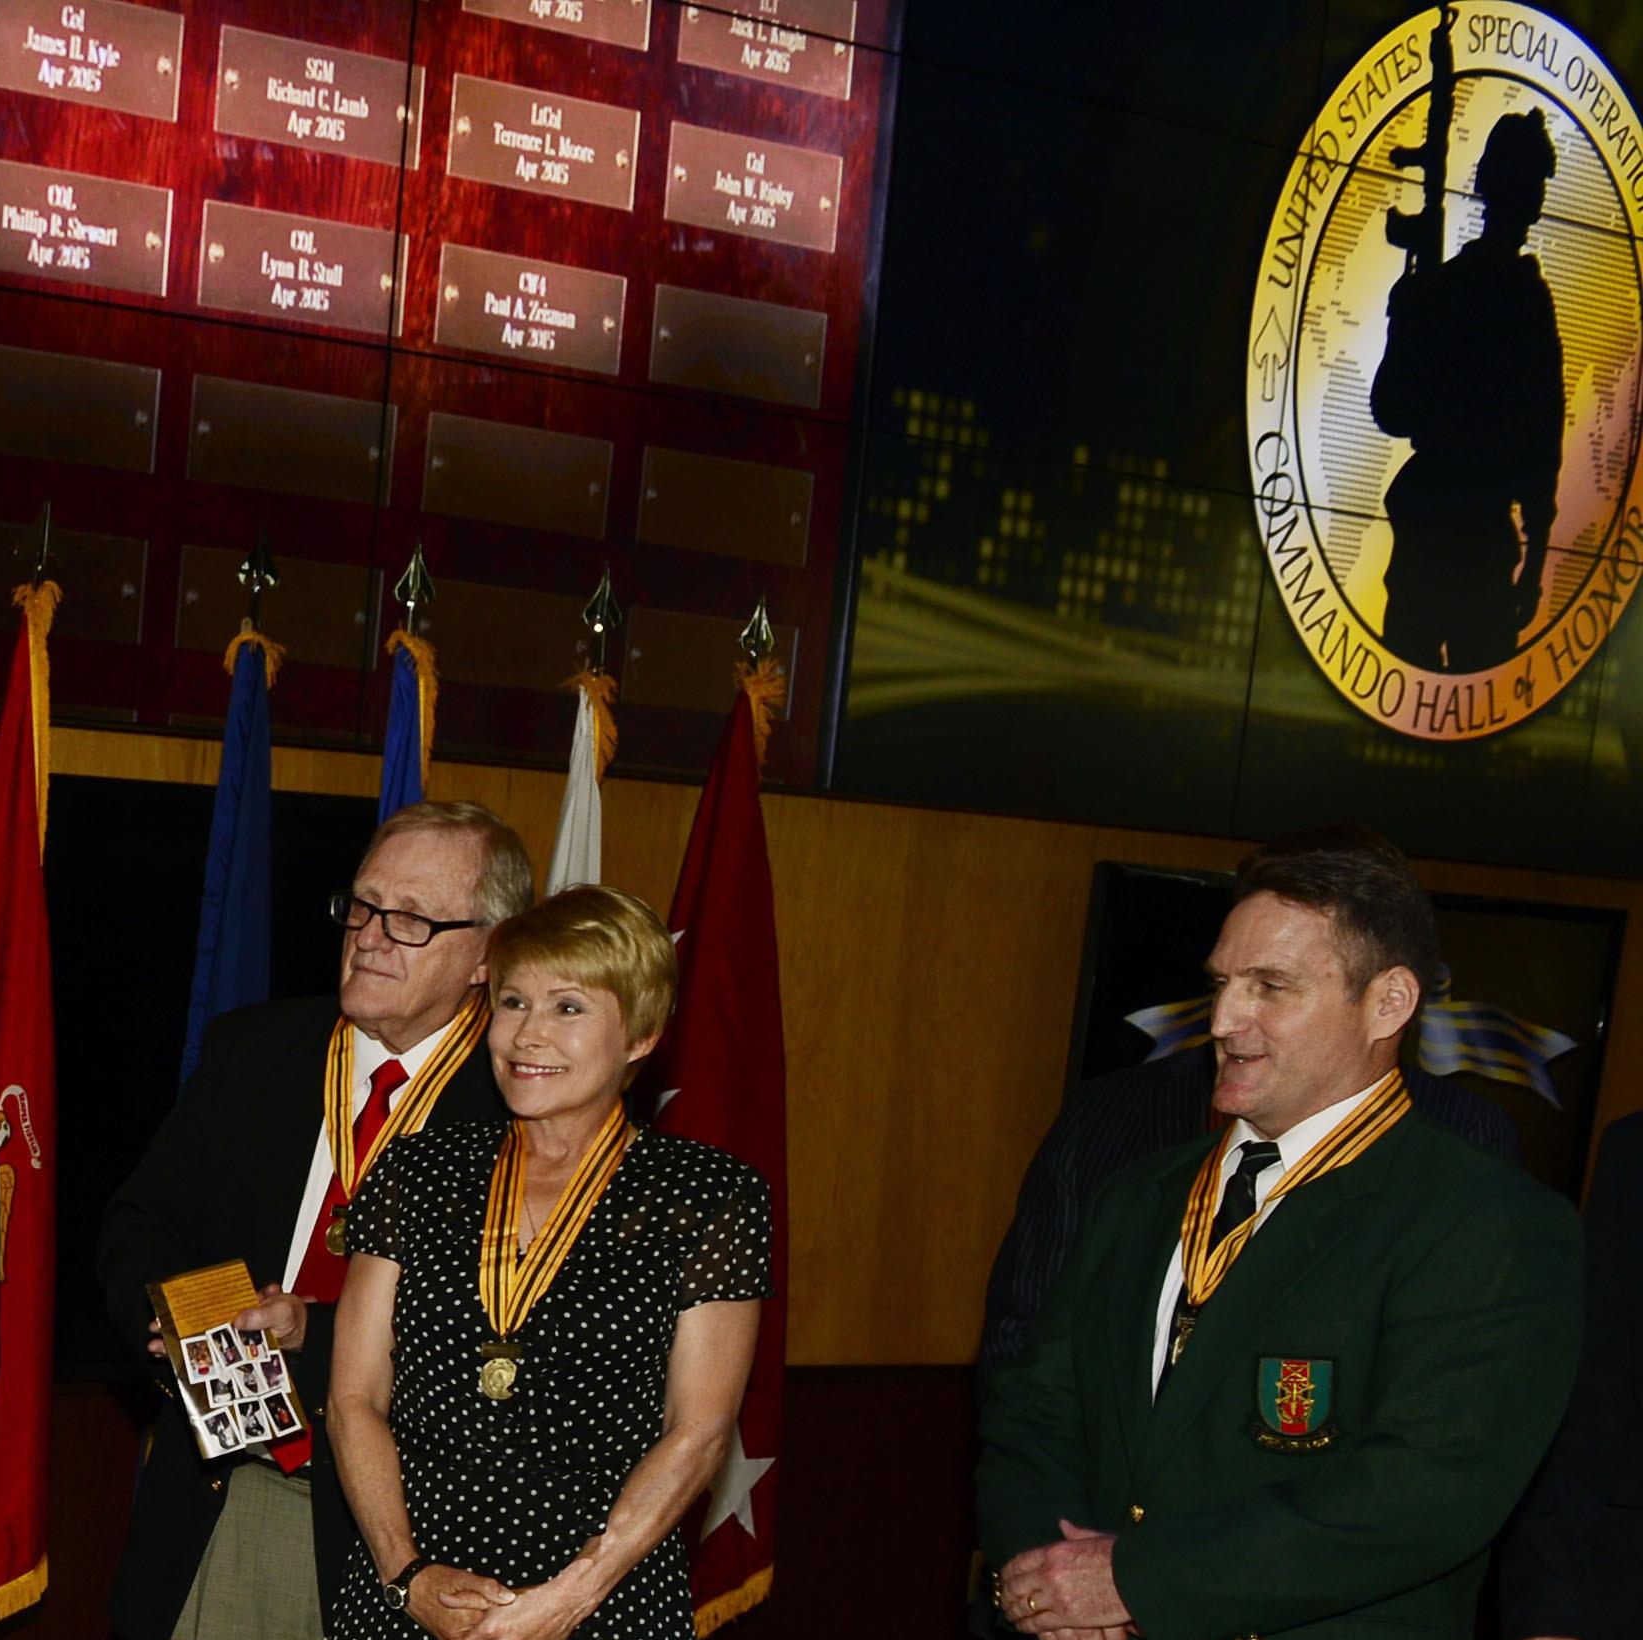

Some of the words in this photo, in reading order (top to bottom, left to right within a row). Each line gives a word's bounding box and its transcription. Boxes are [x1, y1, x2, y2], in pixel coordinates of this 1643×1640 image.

[61, 5, 85, 32] Col
[23, 26, 66, 57] James
[87, 38, 121, 69] Kyle
[741, 43, 762, 69] Apr
[765, 50, 791, 73] 2015
[38, 58, 65, 88] Apr
[68, 66, 102, 92] 2015
[305, 57, 335, 84] SGM
[267, 77, 316, 108] Richard
[318, 88, 330, 111] C.
[333, 91, 369, 118] Lamb
[287, 110, 313, 139] Apr
[315, 116, 346, 142] 2015
[545, 133, 556, 156] L.
[559, 136, 595, 164] Moore
[746, 152, 765, 174] Col
[1267, 129, 1340, 290] UNITED
[1337, 34, 1423, 139] STATES
[1468, 14, 1561, 78] SPECIAL
[515, 155, 538, 182] Apr
[541, 160, 570, 185] 2015
[713, 170, 741, 196] John
[743, 176, 757, 200] W.
[759, 180, 794, 210] Ripley
[2, 205, 48, 239] Phillip
[68, 217, 119, 246] Stewart
[727, 200, 747, 226] Apr
[750, 205, 776, 228] 2015
[28, 239, 54, 268] Apr
[57, 245, 91, 270] 2015
[261, 251, 295, 280] Lynn
[312, 261, 343, 287] Stull
[271, 282, 297, 309] Apr
[299, 287, 330, 311] 2015
[484, 291, 511, 317] Paul
[513, 297, 527, 321] A.
[501, 322, 524, 349] Apr
[527, 327, 556, 350] 2015
[1255, 431, 1406, 718] COMMANDO
[1413, 678, 1508, 734] HALL
[1514, 658, 1536, 709] of
